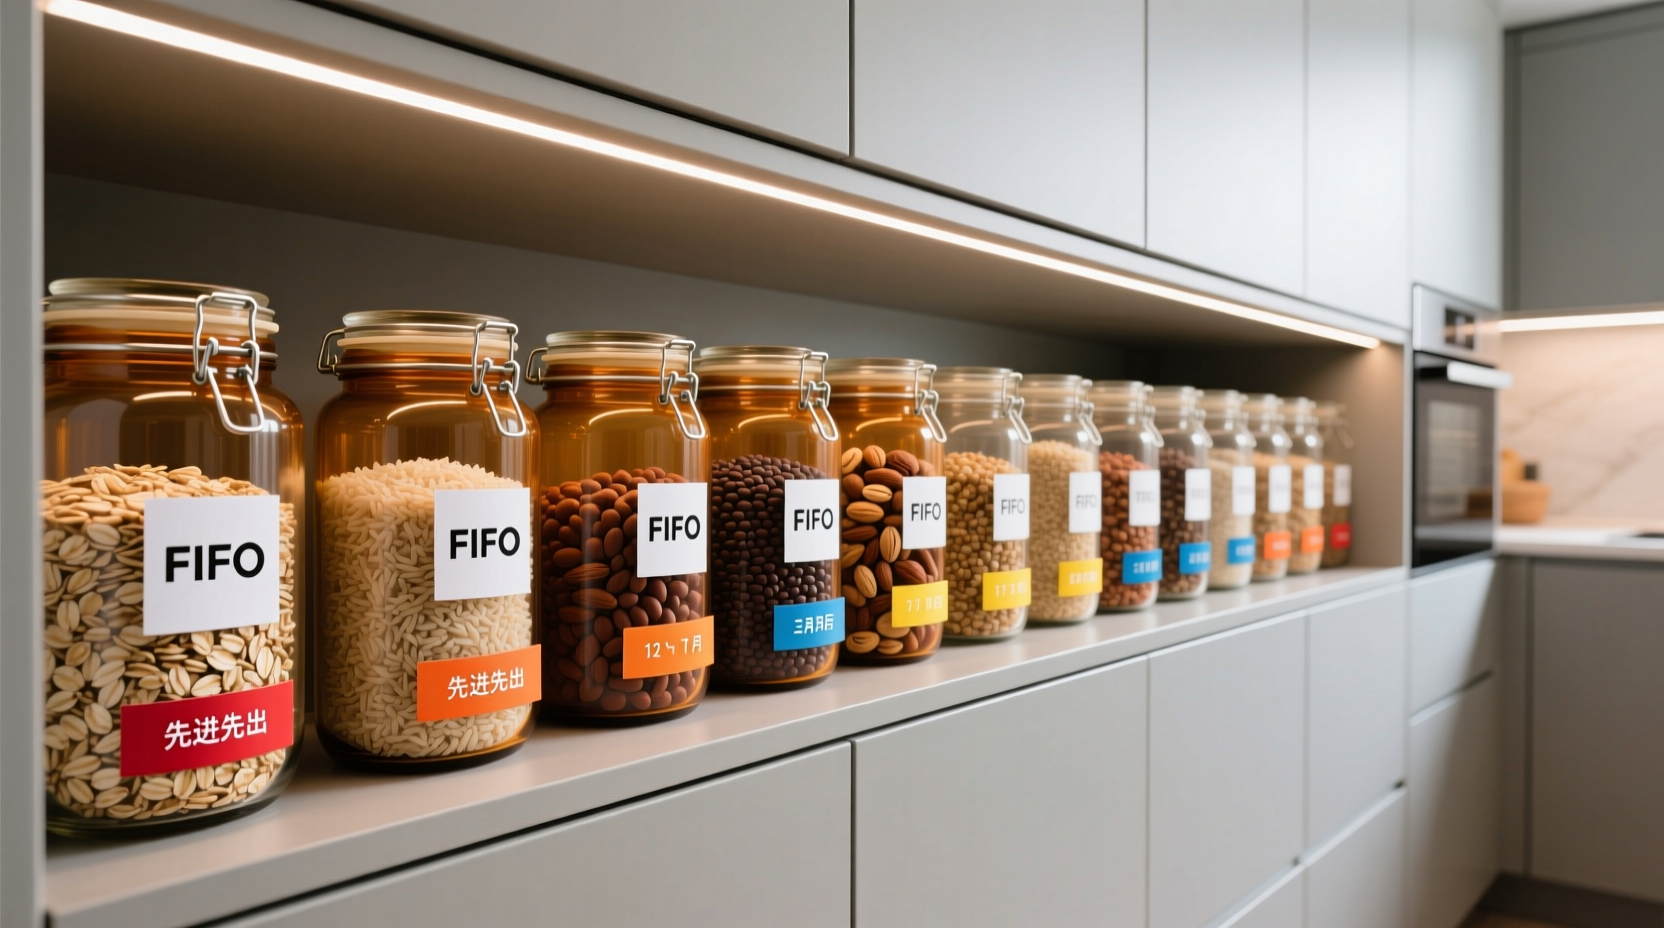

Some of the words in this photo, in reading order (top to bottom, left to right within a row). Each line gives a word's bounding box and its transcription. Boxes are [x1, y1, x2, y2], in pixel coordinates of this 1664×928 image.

[793, 507, 834, 531] FIFO
[910, 502, 942, 522] FIFO
[1000, 498, 1026, 517] FIFO
[449, 526, 521, 560] FIFO
[648, 514, 701, 542] FIFO
[165, 541, 265, 583] FIFO
[446, 667, 525, 701] 先进先出
[164, 708, 268, 751] 先进先出
